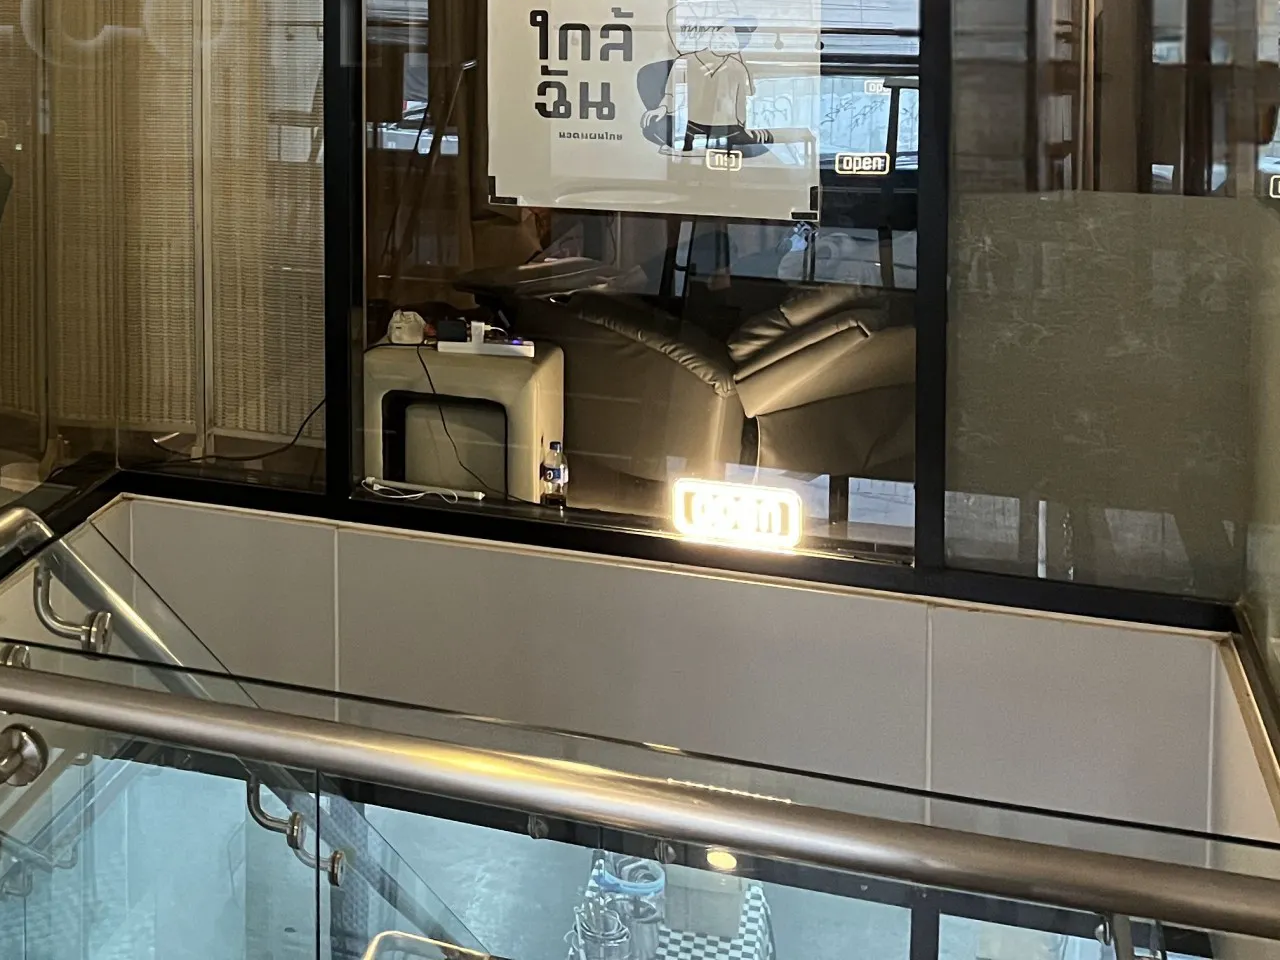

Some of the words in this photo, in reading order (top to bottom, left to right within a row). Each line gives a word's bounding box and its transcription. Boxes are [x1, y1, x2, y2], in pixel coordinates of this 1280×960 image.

[529, 7, 634, 62] ใกล้
[534, 65, 616, 121] ฉัน
[842, 155, 883, 173] open
